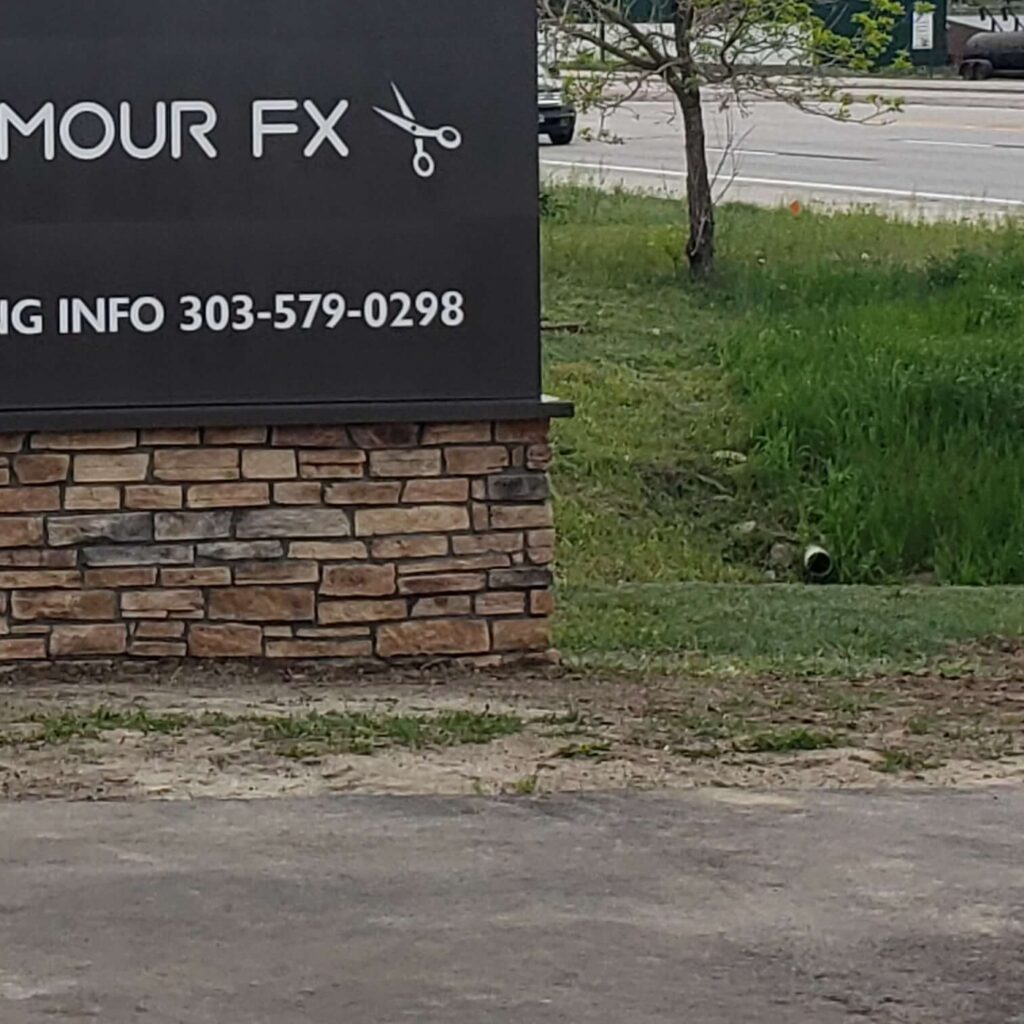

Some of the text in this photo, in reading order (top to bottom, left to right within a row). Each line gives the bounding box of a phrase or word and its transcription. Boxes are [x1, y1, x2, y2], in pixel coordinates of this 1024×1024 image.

[252, 99, 350, 159] FX
[59, 297, 166, 335] INFO
[180, 291, 465, 333] 303-579-0298
